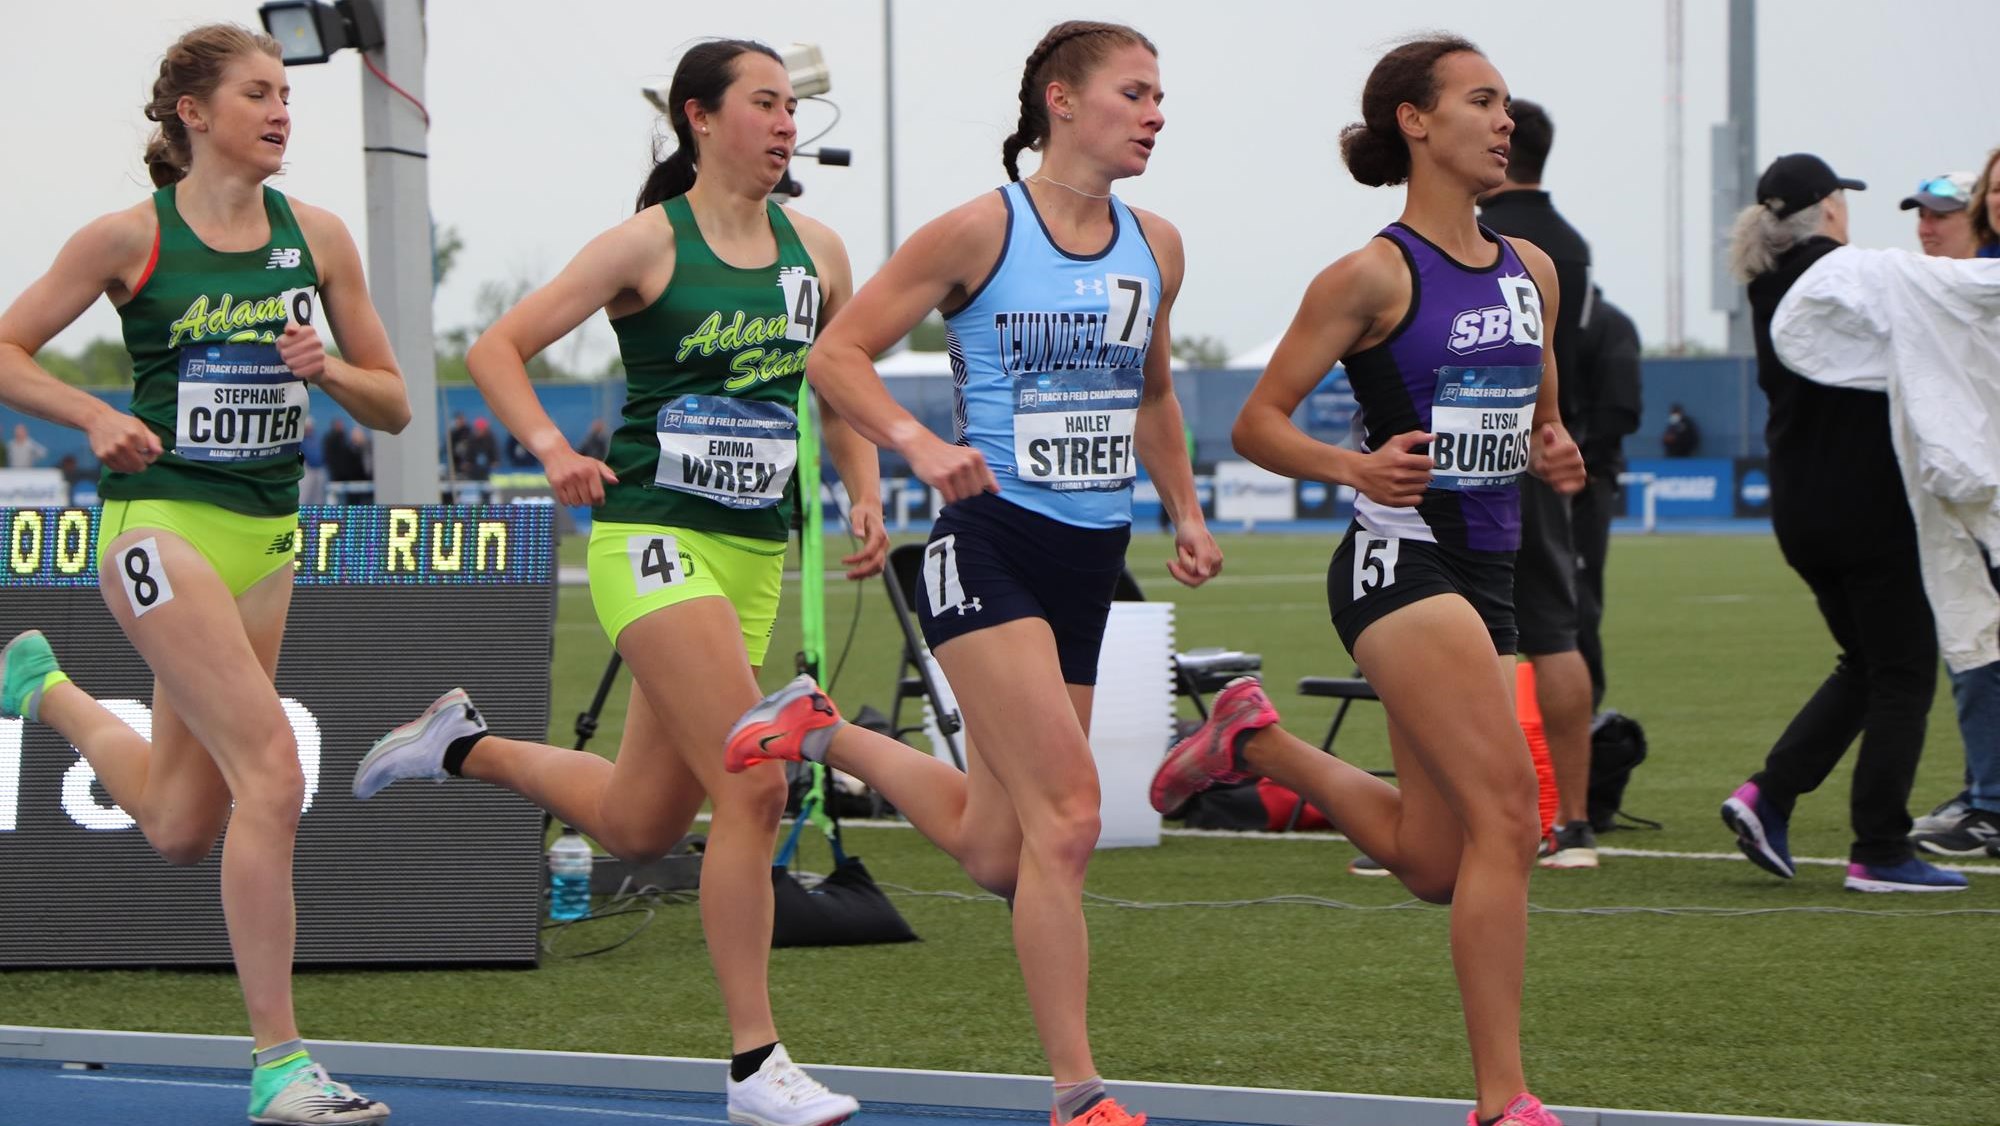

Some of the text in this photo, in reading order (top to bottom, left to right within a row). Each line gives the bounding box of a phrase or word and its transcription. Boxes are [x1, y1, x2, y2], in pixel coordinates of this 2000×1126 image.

[266, 248, 301, 270] NB
[168, 293, 287, 349] Adam
[795, 279, 814, 339] 4
[1117, 278, 1142, 342] 7
[1448, 305, 1513, 355] SB
[1515, 286, 1540, 341] 5
[676, 310, 789, 363] Adam
[205, 364, 231, 374] TRACK
[238, 365, 259, 375] FIELD
[724, 344, 809, 391] Stat
[214, 387, 286, 405] STEPHANIE
[1038, 392, 1063, 402] TRACK
[1069, 391, 1089, 401] FIELD
[1459, 387, 1484, 397] TRACK
[1488, 388, 1507, 397] FIELD
[188, 405, 302, 445] COTTER
[683, 415, 709, 425] TRACK
[715, 416, 737, 427] FIELD
[736, 417, 794, 430] CHAMPIONSHIPS
[1065, 414, 1111, 433] HAILEY
[1481, 412, 1518, 430] ELYSIA
[708, 439, 755, 459] EMMA
[1434, 428, 1531, 473] BURGOS
[681, 453, 777, 494] WREN
[386, 508, 507, 572] Run
[640, 538, 675, 584] 4
[125, 547, 159, 606] 8
[929, 541, 947, 608] 7
[1361, 539, 1388, 594] 5
